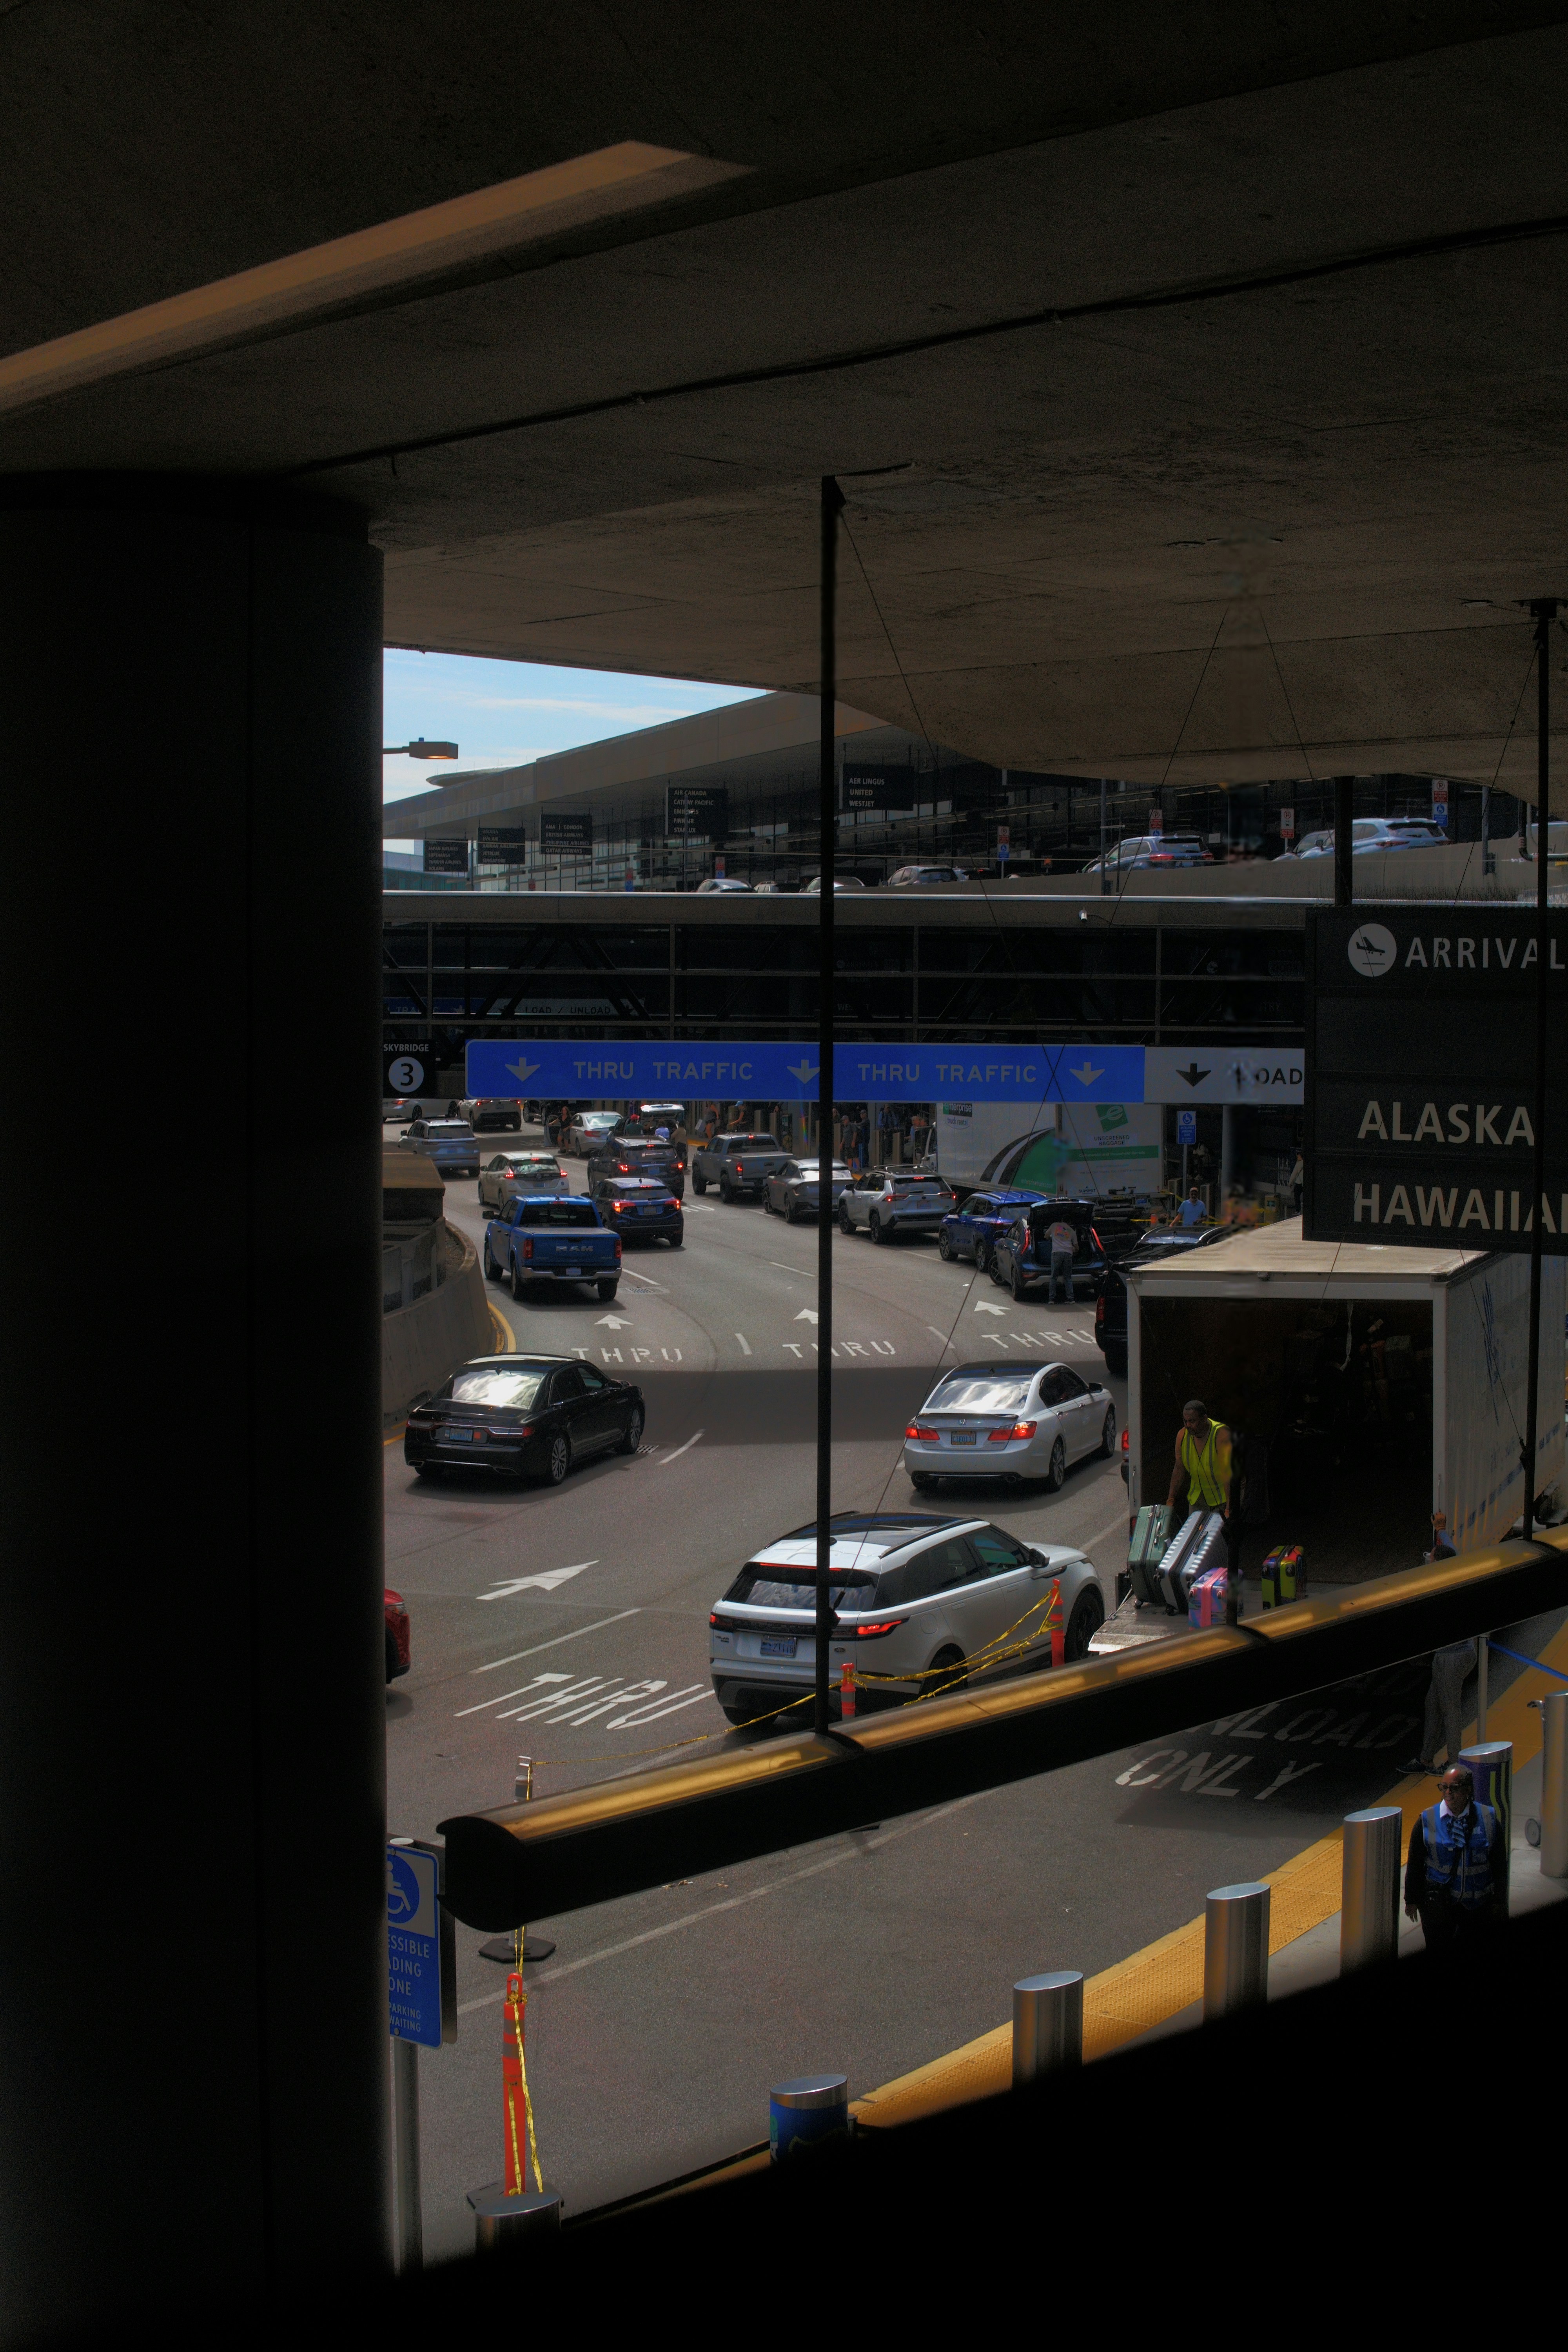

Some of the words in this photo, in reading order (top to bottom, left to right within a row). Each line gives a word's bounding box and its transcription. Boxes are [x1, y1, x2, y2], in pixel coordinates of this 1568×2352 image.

[383, 1043, 429, 1052] SKYBRIDGE
[400, 1063, 414, 1086] 3
[573, 1061, 634, 1079] THRU
[653, 1062, 753, 1080] TRAFFIC
[858, 1064, 920, 1081] THRU
[936, 1064, 1036, 1082] TRAFFIC
[1255, 1068, 1303, 1084] OAD
[944, 1103, 972, 1114] enterprise
[1357, 1101, 1535, 1146] ALASKA
[981, 1329, 1098, 1349] THRU
[571, 1347, 682, 1364] THRU
[453, 1673, 716, 1730] THRU
[1115, 1749, 1324, 1800] ONLY
